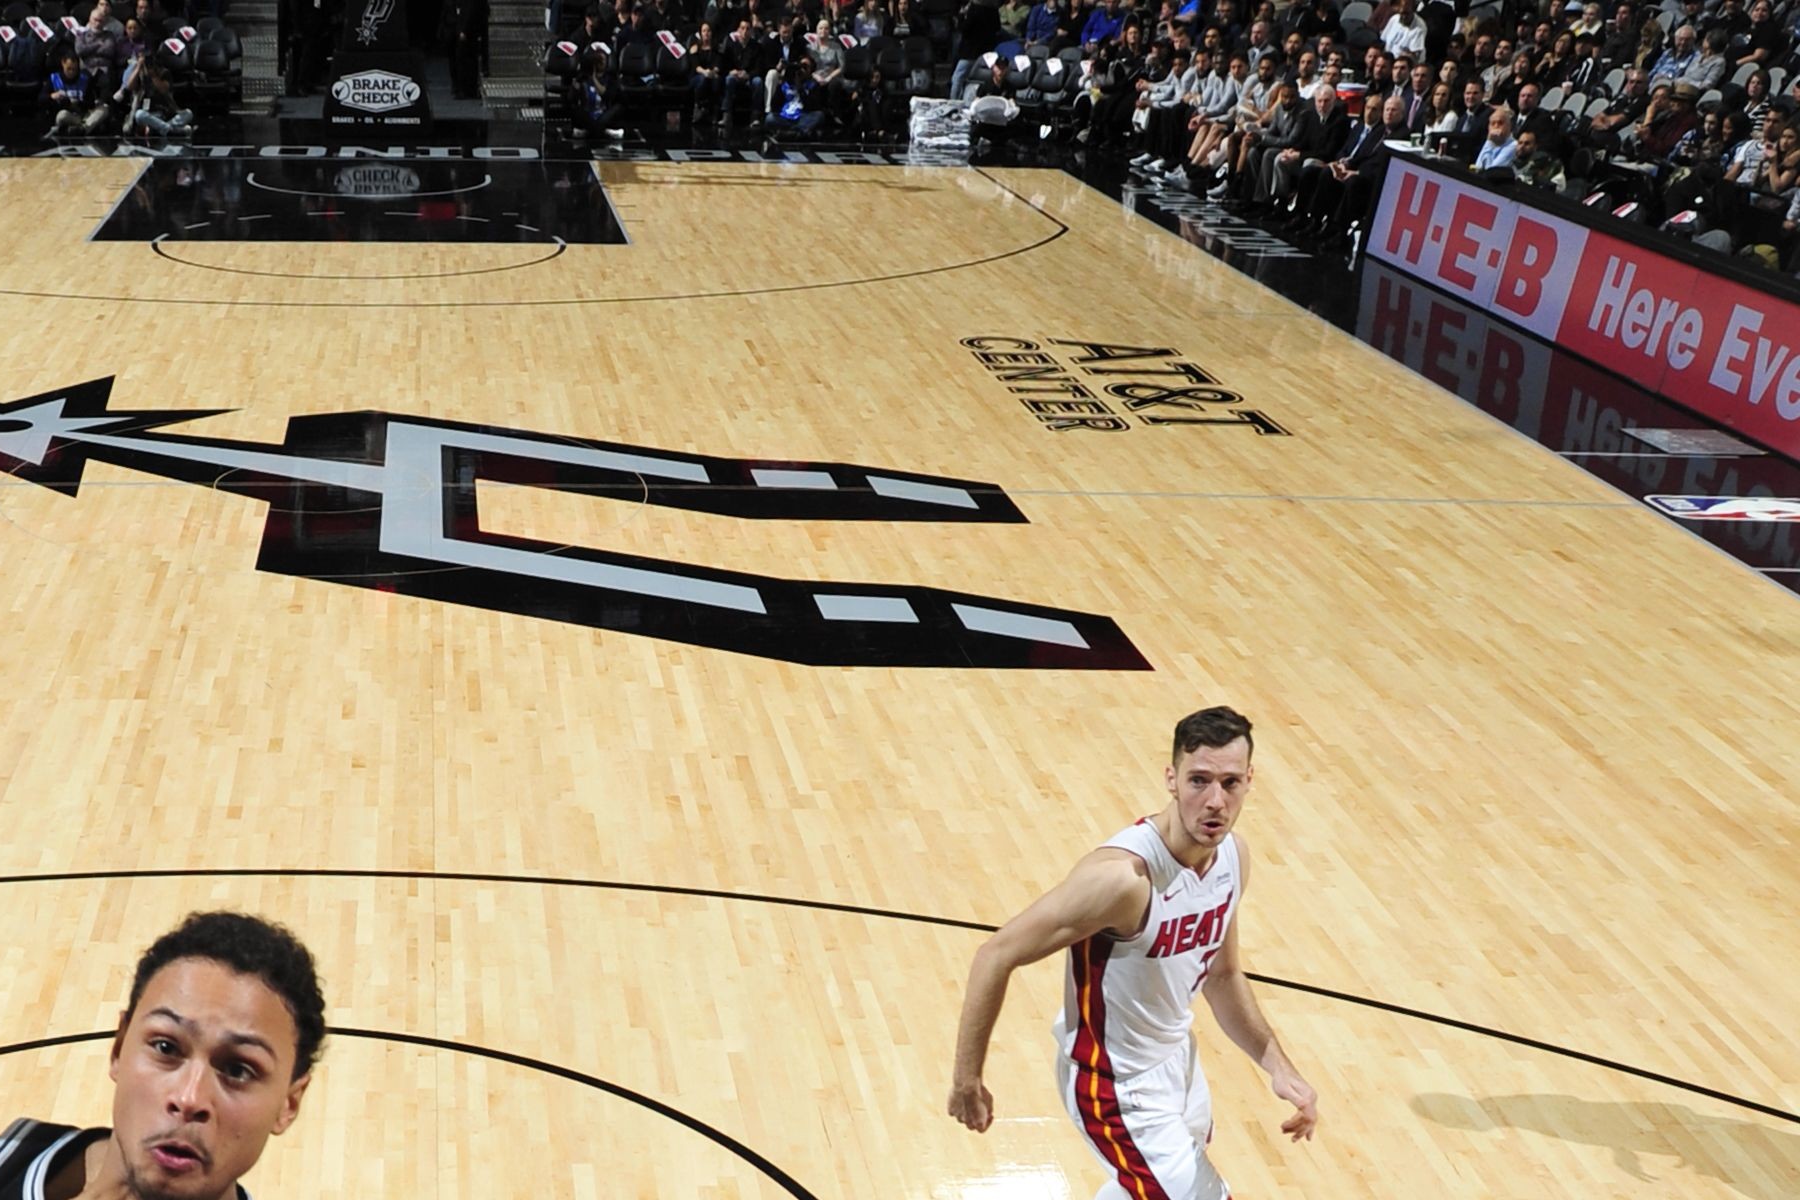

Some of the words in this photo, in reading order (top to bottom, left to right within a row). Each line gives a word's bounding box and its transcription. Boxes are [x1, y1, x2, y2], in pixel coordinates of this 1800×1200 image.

[351, 92, 400, 104] CHECK
[352, 79, 401, 90] BRAKE
[30, 145, 540, 158] ANTONIO
[1588, 255, 1703, 370] Here
[959, 336, 1131, 431] CENTER
[1046, 338, 1293, 436] AT&T
[1145, 885, 1234, 958] HEAT
